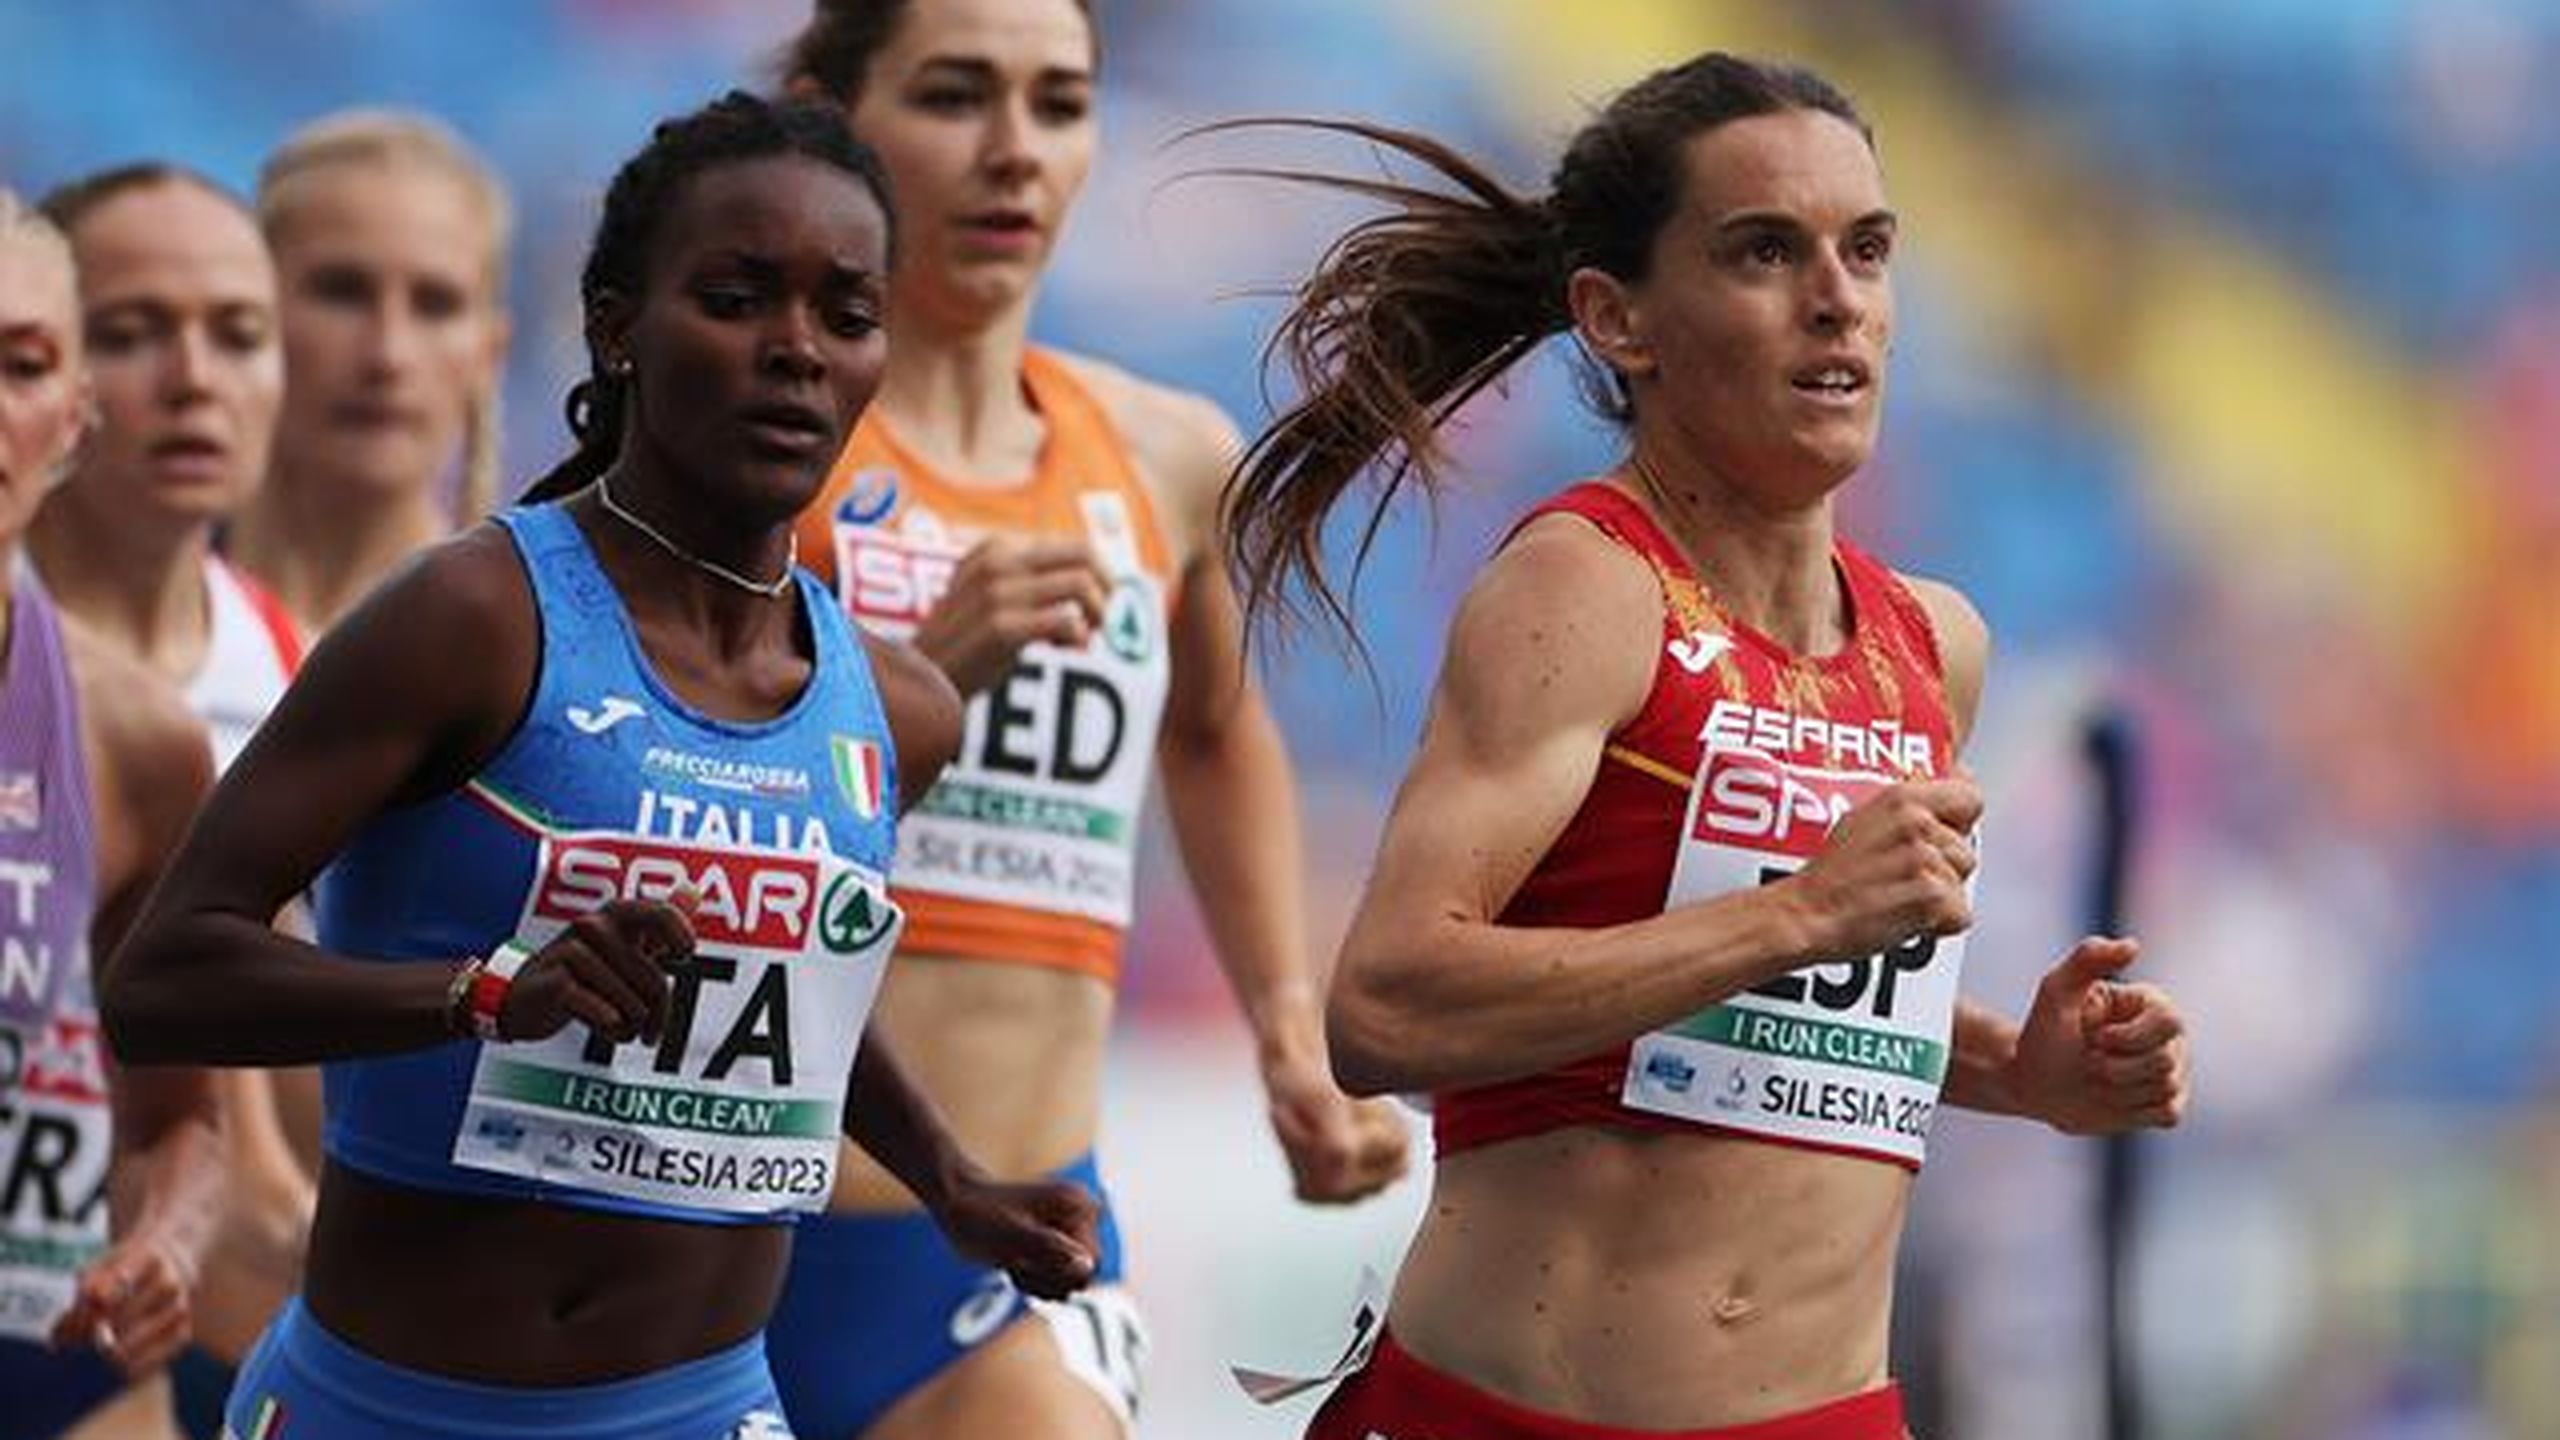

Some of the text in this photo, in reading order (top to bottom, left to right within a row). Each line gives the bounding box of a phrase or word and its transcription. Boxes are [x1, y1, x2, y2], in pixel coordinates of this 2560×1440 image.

[979, 660, 1126, 785] ED
[1698, 700, 1935, 778] ESPAÑA
[635, 789, 834, 857] ITALIA
[546, 849, 806, 938] SPAR
[1730, 1013, 1916, 1072] I RUN CLEAN
[582, 1080, 663, 1122] RUN
[666, 1094, 777, 1133] CLEAN
[1760, 1074, 1898, 1132] SILESIA
[590, 1134, 829, 1196] SILESIA 2023
